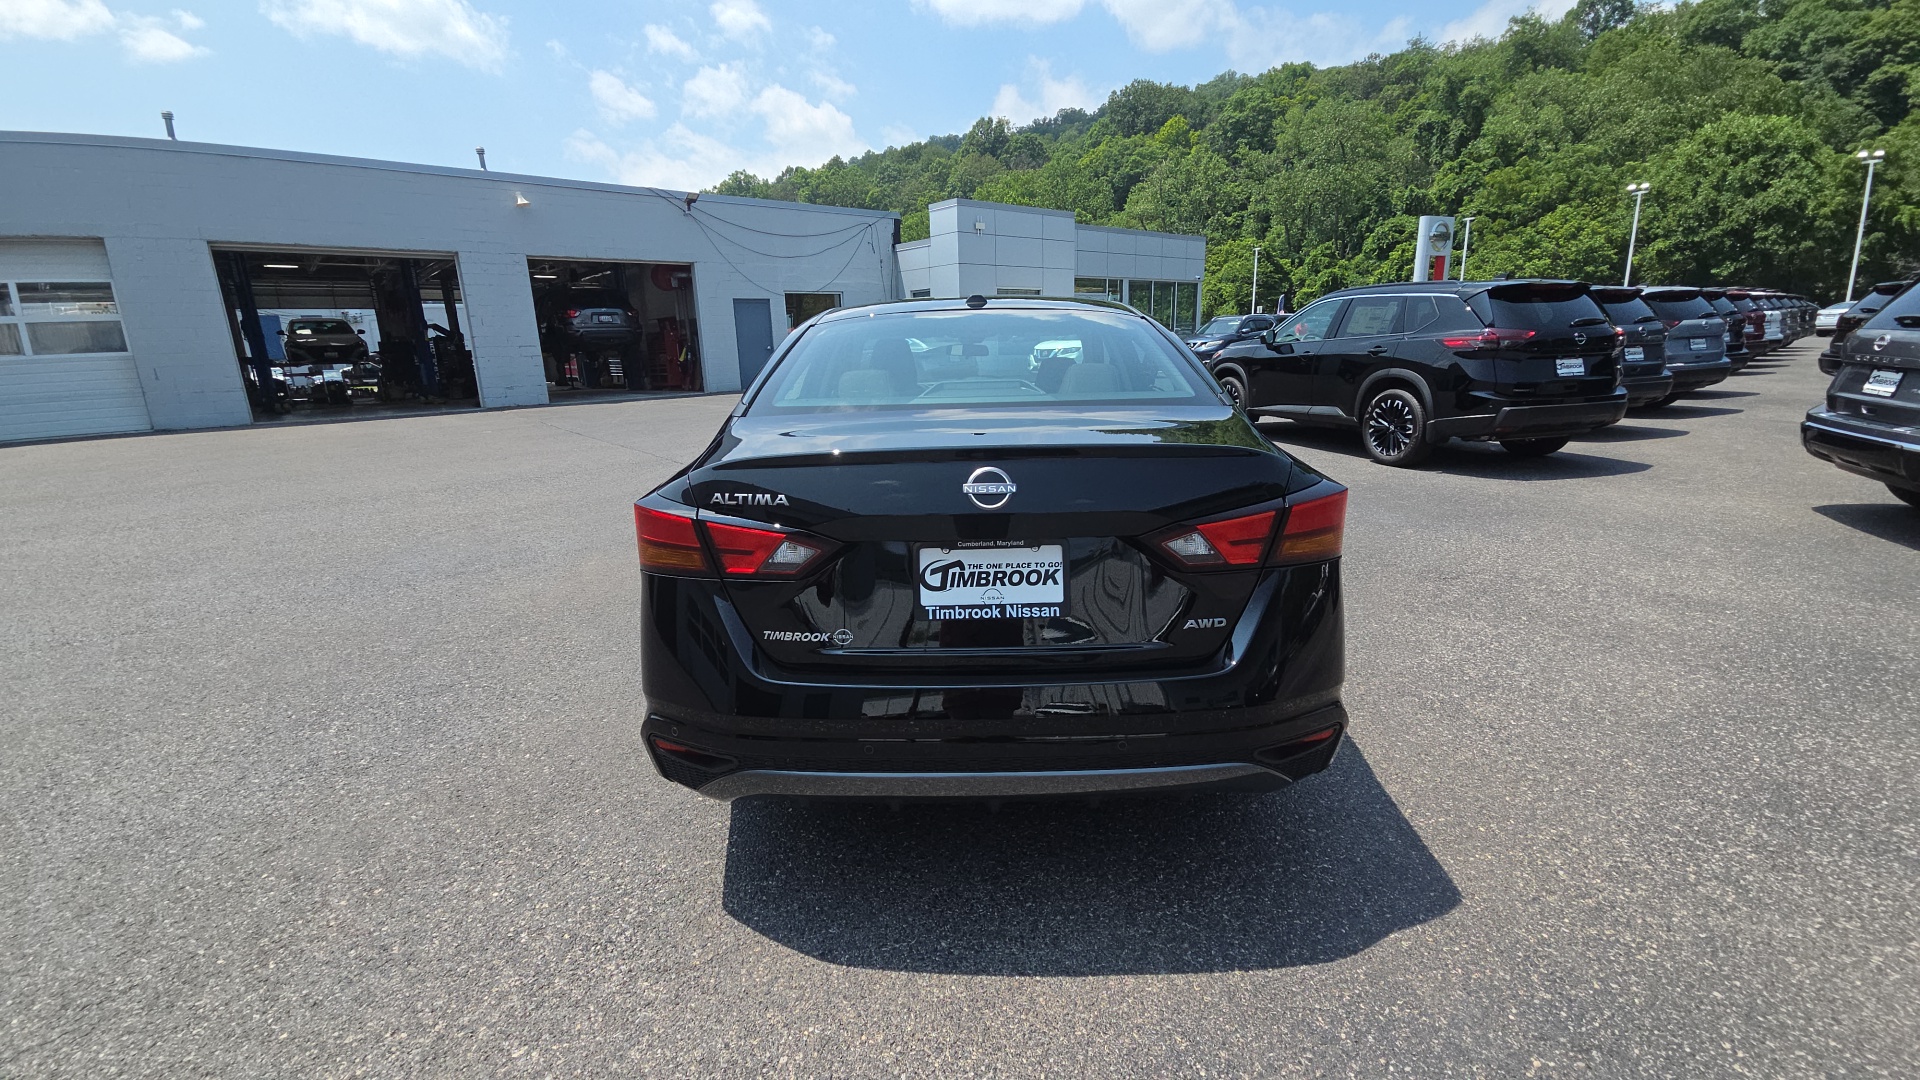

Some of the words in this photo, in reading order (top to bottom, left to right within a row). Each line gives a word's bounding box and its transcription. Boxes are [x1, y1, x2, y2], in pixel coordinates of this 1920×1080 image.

[964, 485, 1016, 493] NISSAN
[710, 492, 790, 506] ALTIMA
[996, 540, 1024, 548] Maryland
[920, 559, 1061, 592] TIMBROOK
[925, 605, 1002, 620] Timbrook
[1005, 604, 1060, 618] Nissan
[1183, 617, 1227, 630] AWD
[763, 630, 832, 642] TIMBROOK
